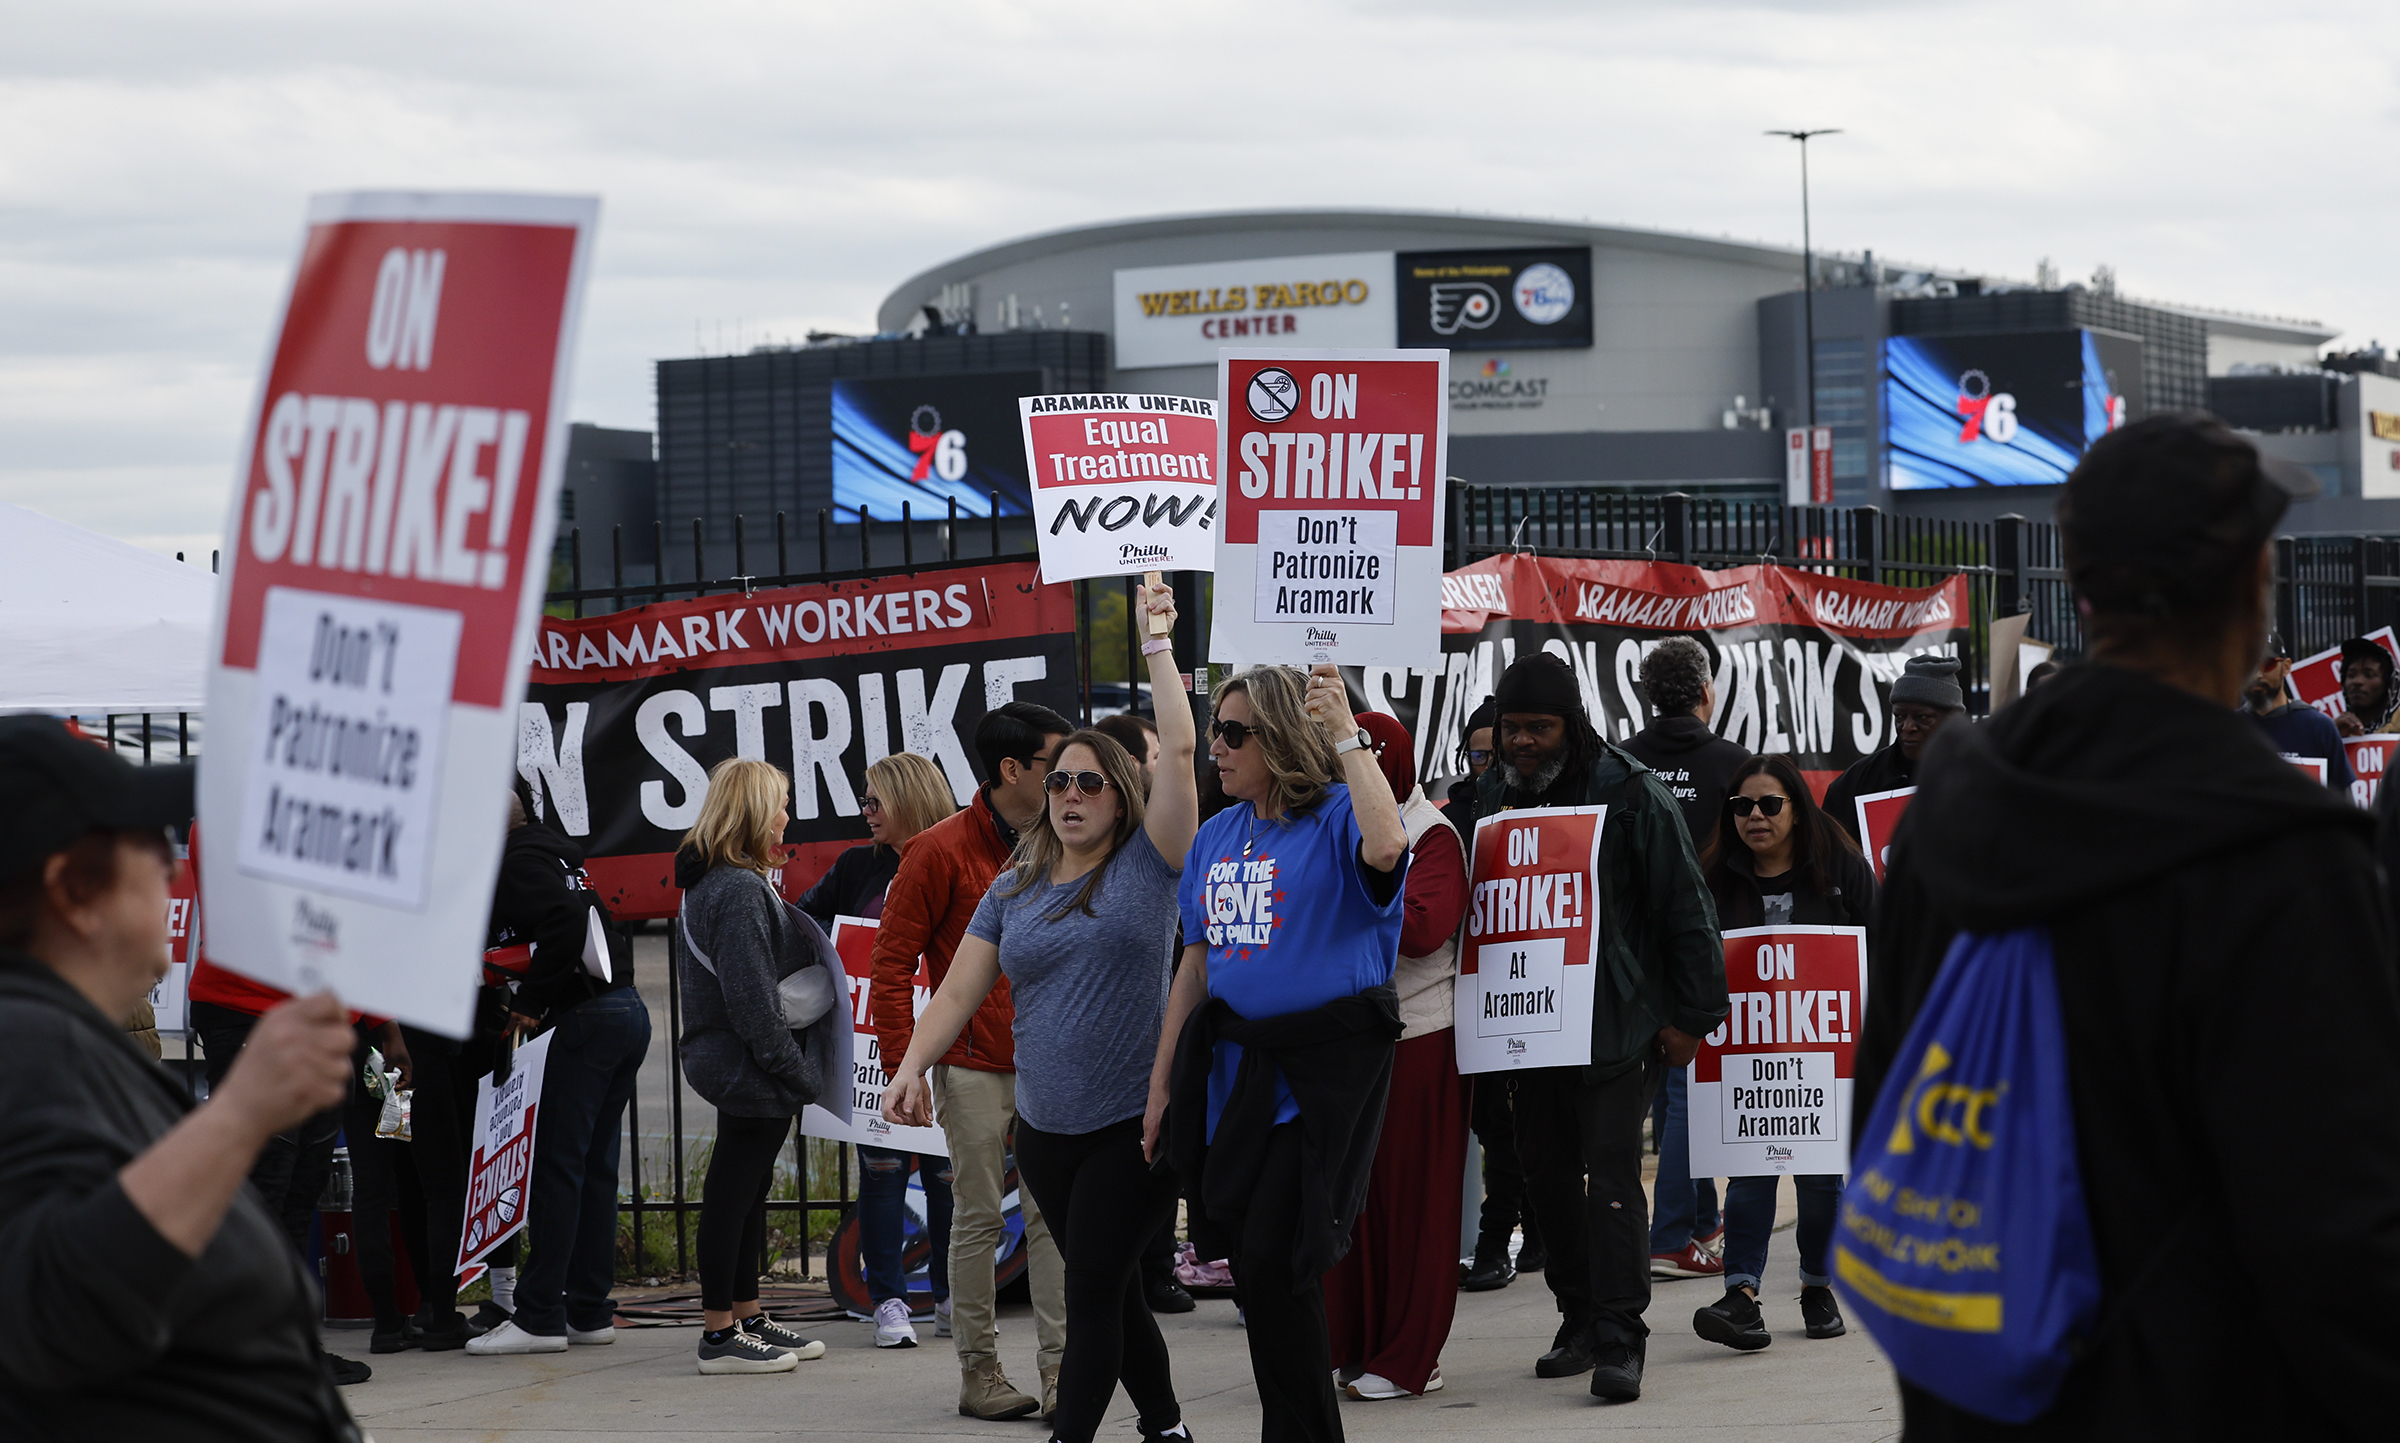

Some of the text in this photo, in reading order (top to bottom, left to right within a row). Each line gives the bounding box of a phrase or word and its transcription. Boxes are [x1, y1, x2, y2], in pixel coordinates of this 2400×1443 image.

[365, 247, 446, 371] ON
[1138, 278, 1368, 317] WELLS FARGO
[1202, 314, 1297, 339] CENTER
[1031, 395, 1213, 417] ARAMARK UNFAIR
[1310, 373, 1357, 420] ON
[1085, 418, 1169, 449] Equal
[1957, 393, 2018, 442] 76
[908, 429, 968, 483] 76
[1049, 450, 1212, 481] Treatment
[1239, 432, 1424, 500] STRIKE!
[250, 391, 530, 590] STRIKE!
[1050, 492, 1217, 536] NOW!
[1297, 516, 1357, 545] Don't
[1119, 543, 1168, 557] Philly
[1272, 550, 1380, 581] Patronize
[1276, 585, 1374, 615] Aramark
[1441, 573, 1507, 612] ORKERS
[1575, 582, 1756, 628] ARAMARK WORKERS
[1815, 588, 1905, 630] ARAMARK
[526, 584, 972, 670] ARAMARK WORKERS
[1306, 626, 1337, 642] Philly
[263, 693, 420, 791] Patronize
[517, 702, 590, 836] N
[1676, 768, 1690, 781] in
[2357, 746, 2383, 774] ON
[258, 786, 402, 881] Aramark
[1507, 827, 1540, 867] ON
[1207, 859, 1276, 884] FOR THE
[1205, 881, 1273, 925] LOVE
[1218, 896, 1233, 912] 76
[1469, 872, 1583, 937] STRIKE!
[1206, 923, 1273, 946] OF PHILLY
[1509, 951, 1526, 980] At
[1756, 944, 1795, 981] ON
[1483, 986, 1555, 1019] Aramark
[1752, 1058, 1804, 1082] Don't
[1733, 1084, 1824, 1110] Patronize
[869, 1118, 890, 1131] Philly
[1738, 1113, 1821, 1138] Aramark
[1766, 1144, 1792, 1157] Philly
[470, 1135, 529, 1219] STRIKE!
